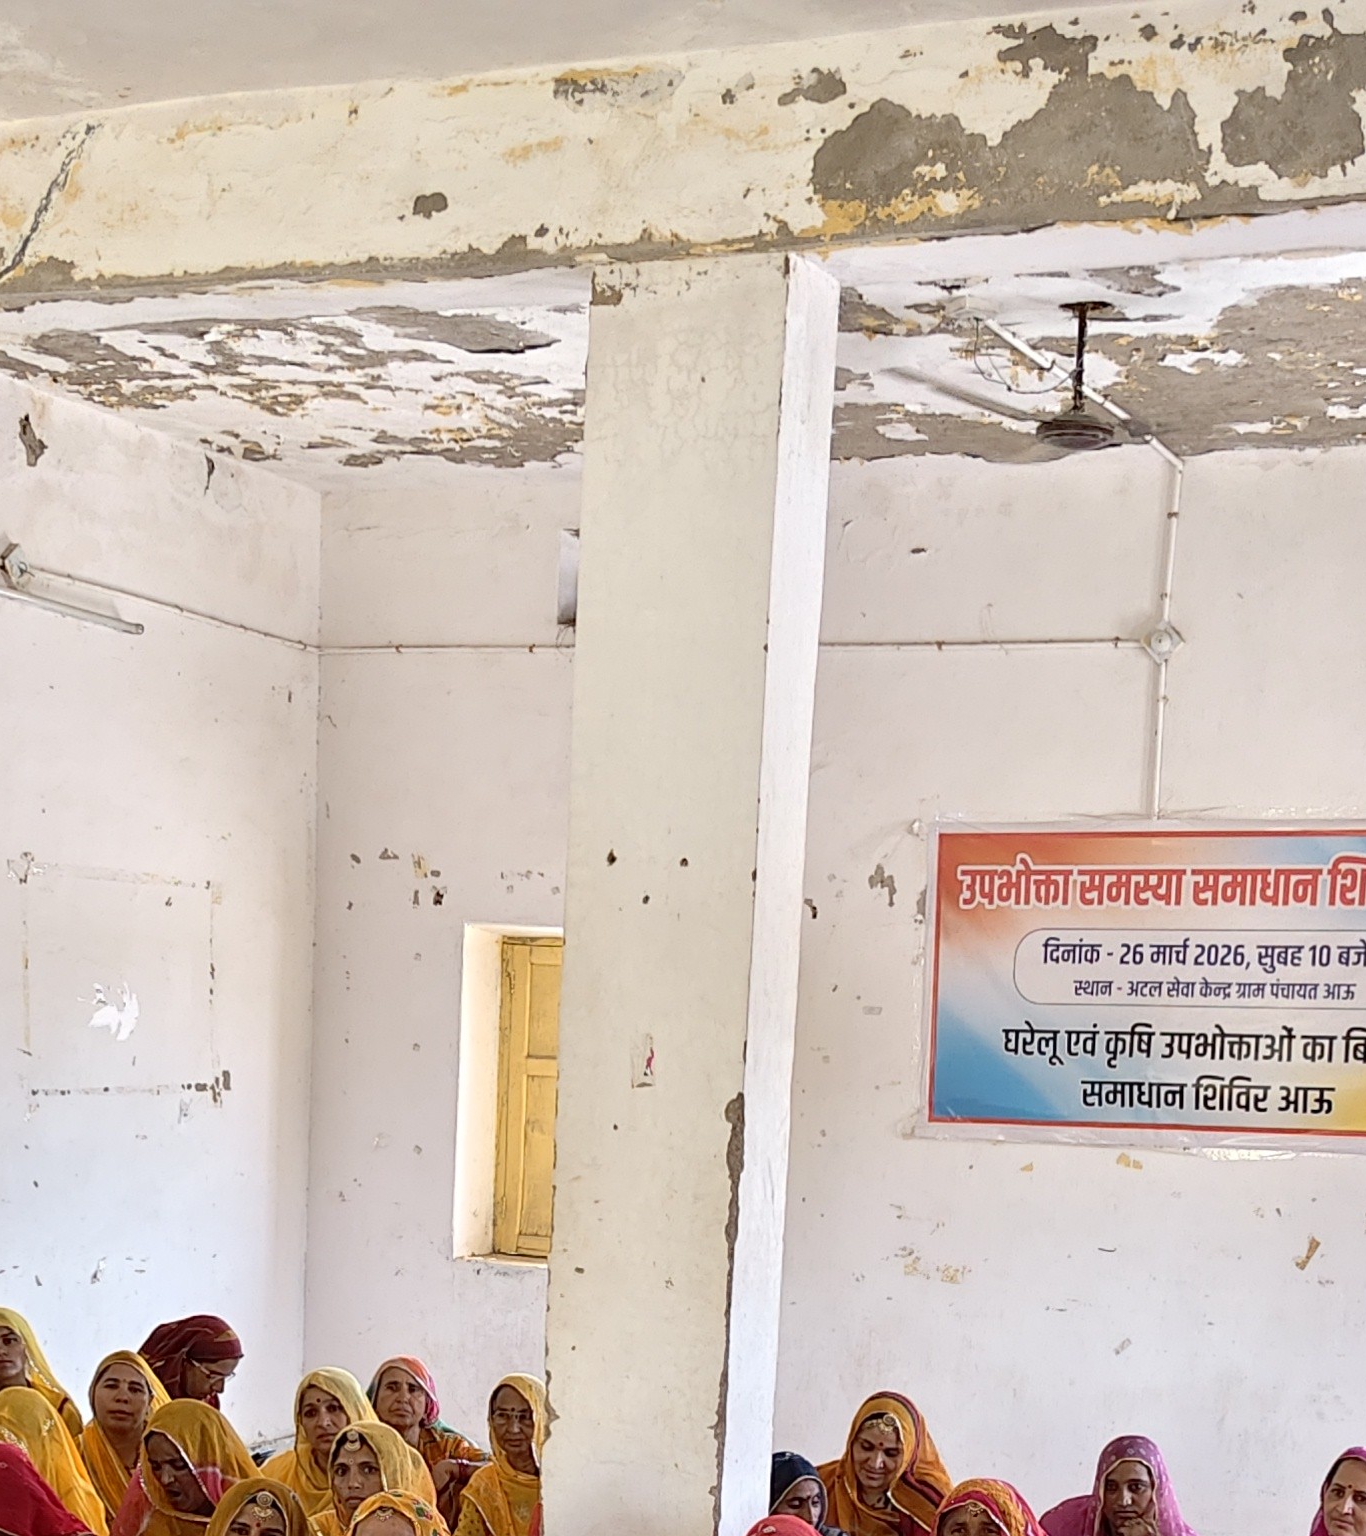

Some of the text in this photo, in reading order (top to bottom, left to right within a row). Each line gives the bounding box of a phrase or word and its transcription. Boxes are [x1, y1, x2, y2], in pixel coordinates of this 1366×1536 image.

[958, 856, 1074, 907] उपभोक्ता
[1077, 867, 1187, 907] समस्या
[1191, 867, 1324, 907] समाधान
[1041, 936, 1103, 965] दिनांक
[1118, 943, 1145, 966] 26
[1148, 938, 1190, 966] मार्च
[1193, 944, 1251, 970] 2026,
[1256, 945, 1305, 973] सुबह
[1308, 945, 1332, 967] 10
[1073, 979, 1114, 997] स्थान
[1126, 980, 1164, 998] अटल
[1166, 976, 1197, 998] सेवा
[1198, 976, 1233, 1001] केन्द्र
[1235, 982, 1267, 1000] ग्राम
[1269, 978, 1319, 1000] पंचायत
[1322, 983, 1357, 1001] आऊ
[1001, 1020, 1065, 1066] घरेलू
[1065, 1023, 1100, 1057] एवं
[1104, 1022, 1156, 1069] कृषि
[1160, 1023, 1297, 1063] उपभोक्ताओं
[1300, 1034, 1338, 1064] का
[1080, 1074, 1336, 1114] समाधान शिविर आऊ
